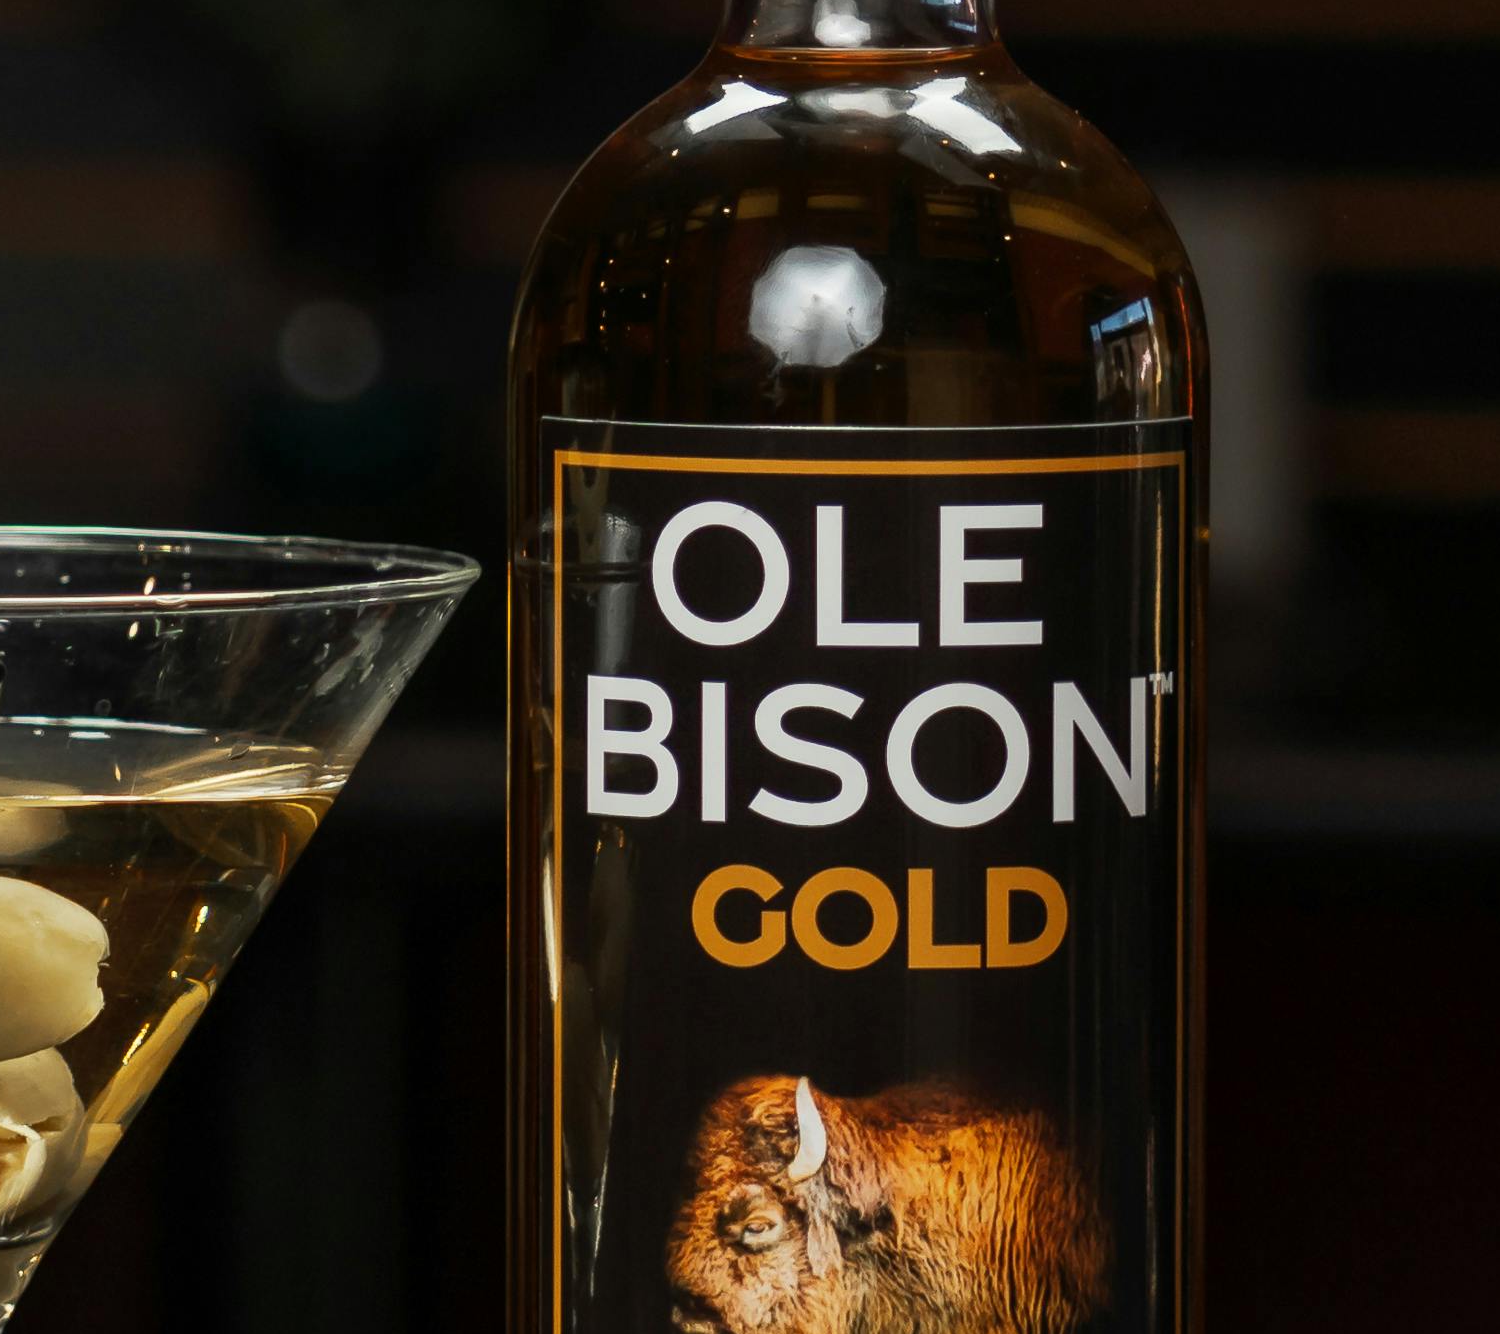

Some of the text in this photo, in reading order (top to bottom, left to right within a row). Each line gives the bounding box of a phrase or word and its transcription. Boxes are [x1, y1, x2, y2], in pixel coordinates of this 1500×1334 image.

[652, 501, 1043, 647] OLE
[587, 675, 1146, 828] BISON
[692, 864, 1068, 970] GOLD
